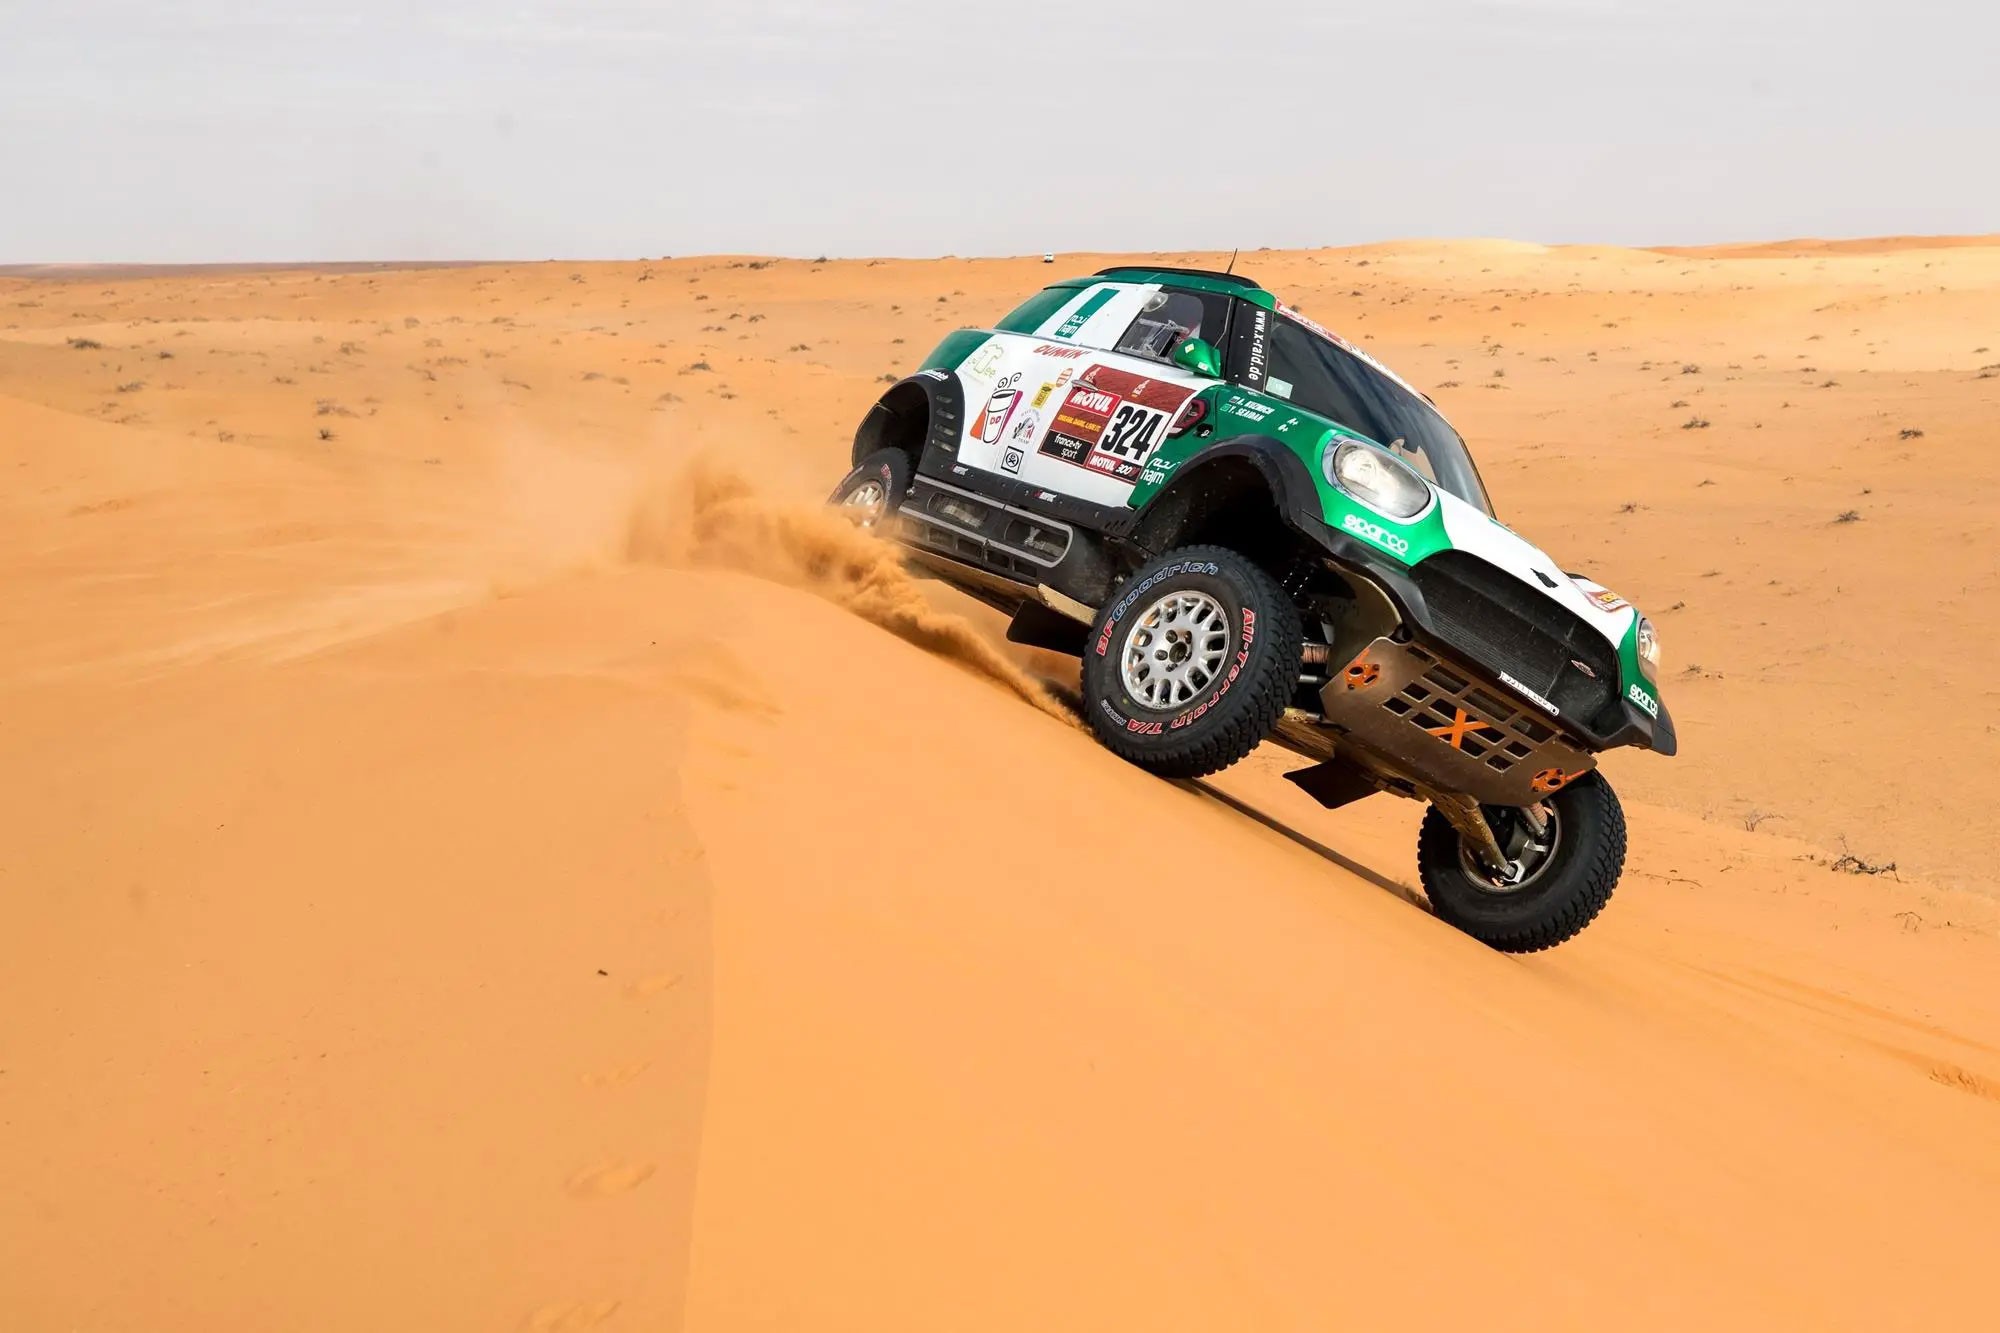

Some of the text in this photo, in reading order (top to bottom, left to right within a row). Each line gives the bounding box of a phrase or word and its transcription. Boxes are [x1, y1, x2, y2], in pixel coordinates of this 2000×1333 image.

[1247, 310, 1266, 381] www.x-raid.de
[1071, 389, 1114, 413] MOTUL
[1100, 405, 1164, 461] 324
[1061, 448, 1078, 459] sport
[1089, 454, 1118, 471] MOTUL
[1139, 468, 1165, 486] najm
[1344, 514, 1409, 554] sparco
[1127, 606, 1256, 735] All-Terrain T/A
